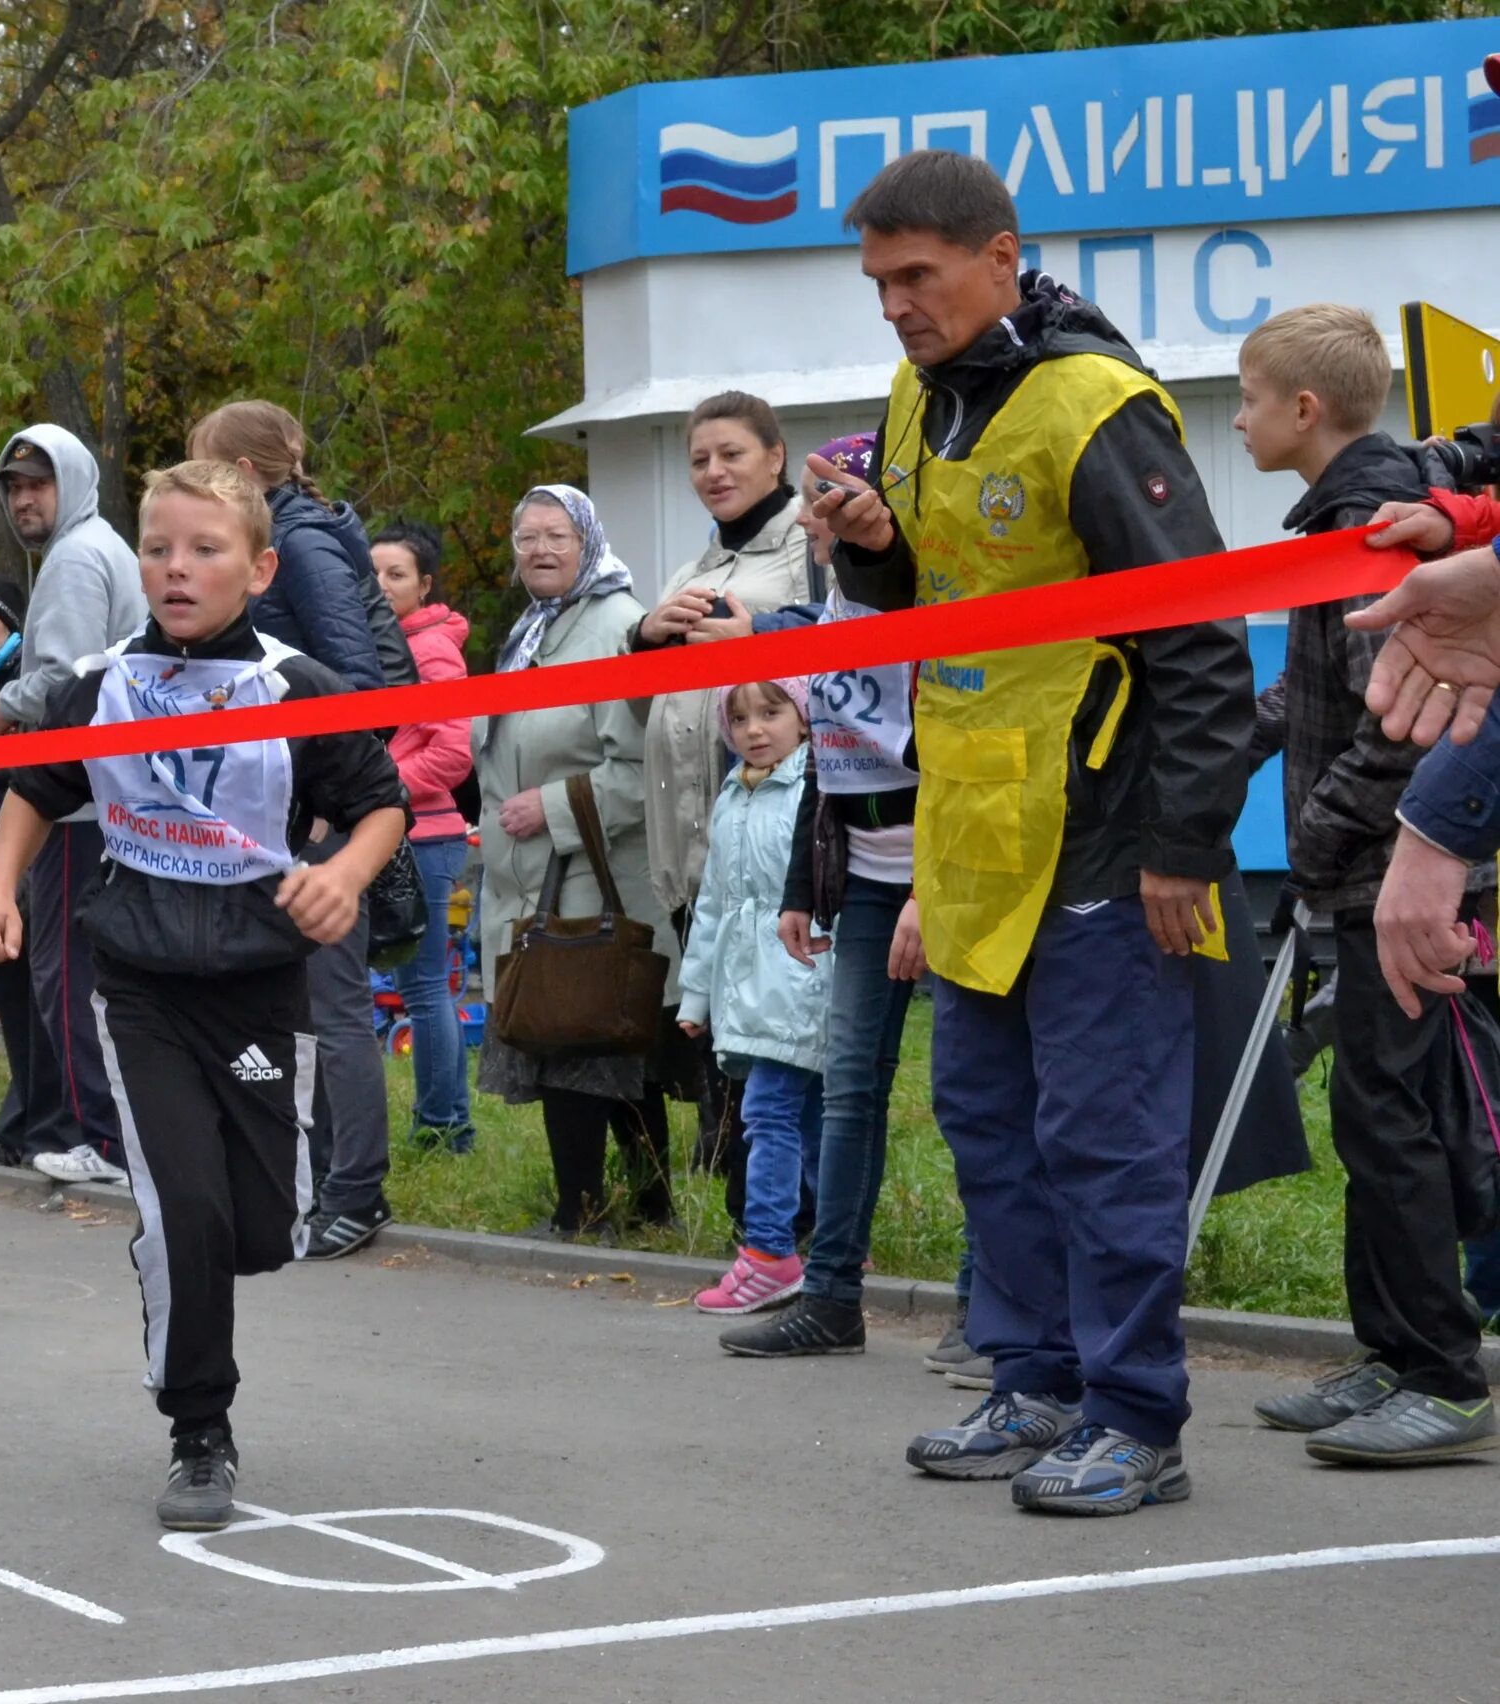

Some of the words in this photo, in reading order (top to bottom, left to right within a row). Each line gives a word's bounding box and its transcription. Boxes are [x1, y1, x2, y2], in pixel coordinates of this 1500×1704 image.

[1018, 229, 1271, 341] ПС
[107, 802, 159, 839] КРОСС
[165, 821, 225, 849] НАЦИИ
[105, 833, 202, 878] КУРГАНСКАЯ
